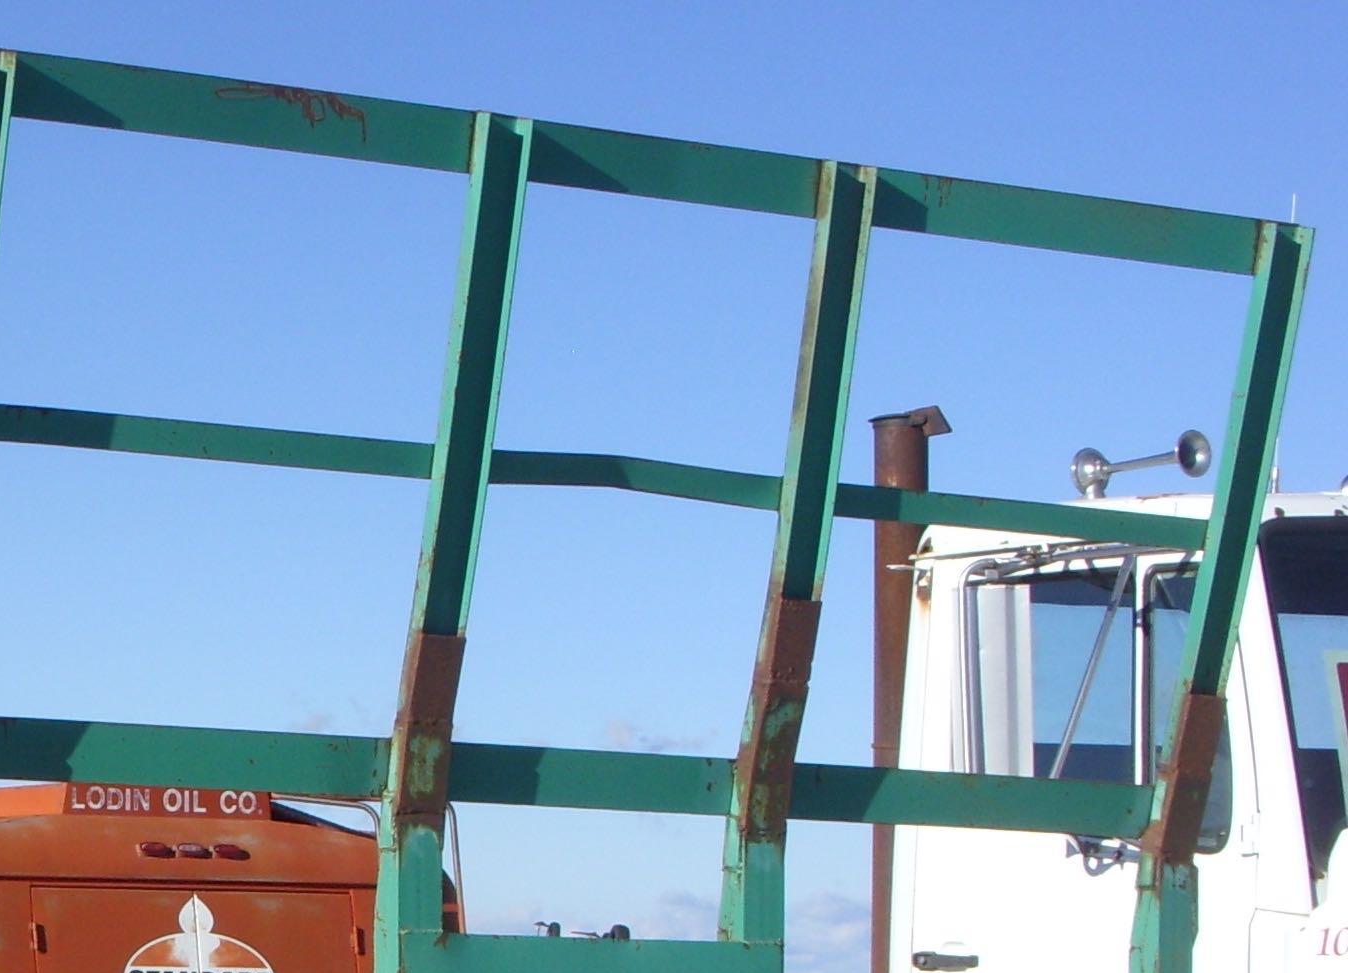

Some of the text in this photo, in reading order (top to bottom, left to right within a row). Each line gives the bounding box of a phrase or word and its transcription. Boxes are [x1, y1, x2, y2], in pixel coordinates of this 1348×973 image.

[71, 785, 263, 814] LODIN OIL CO.
